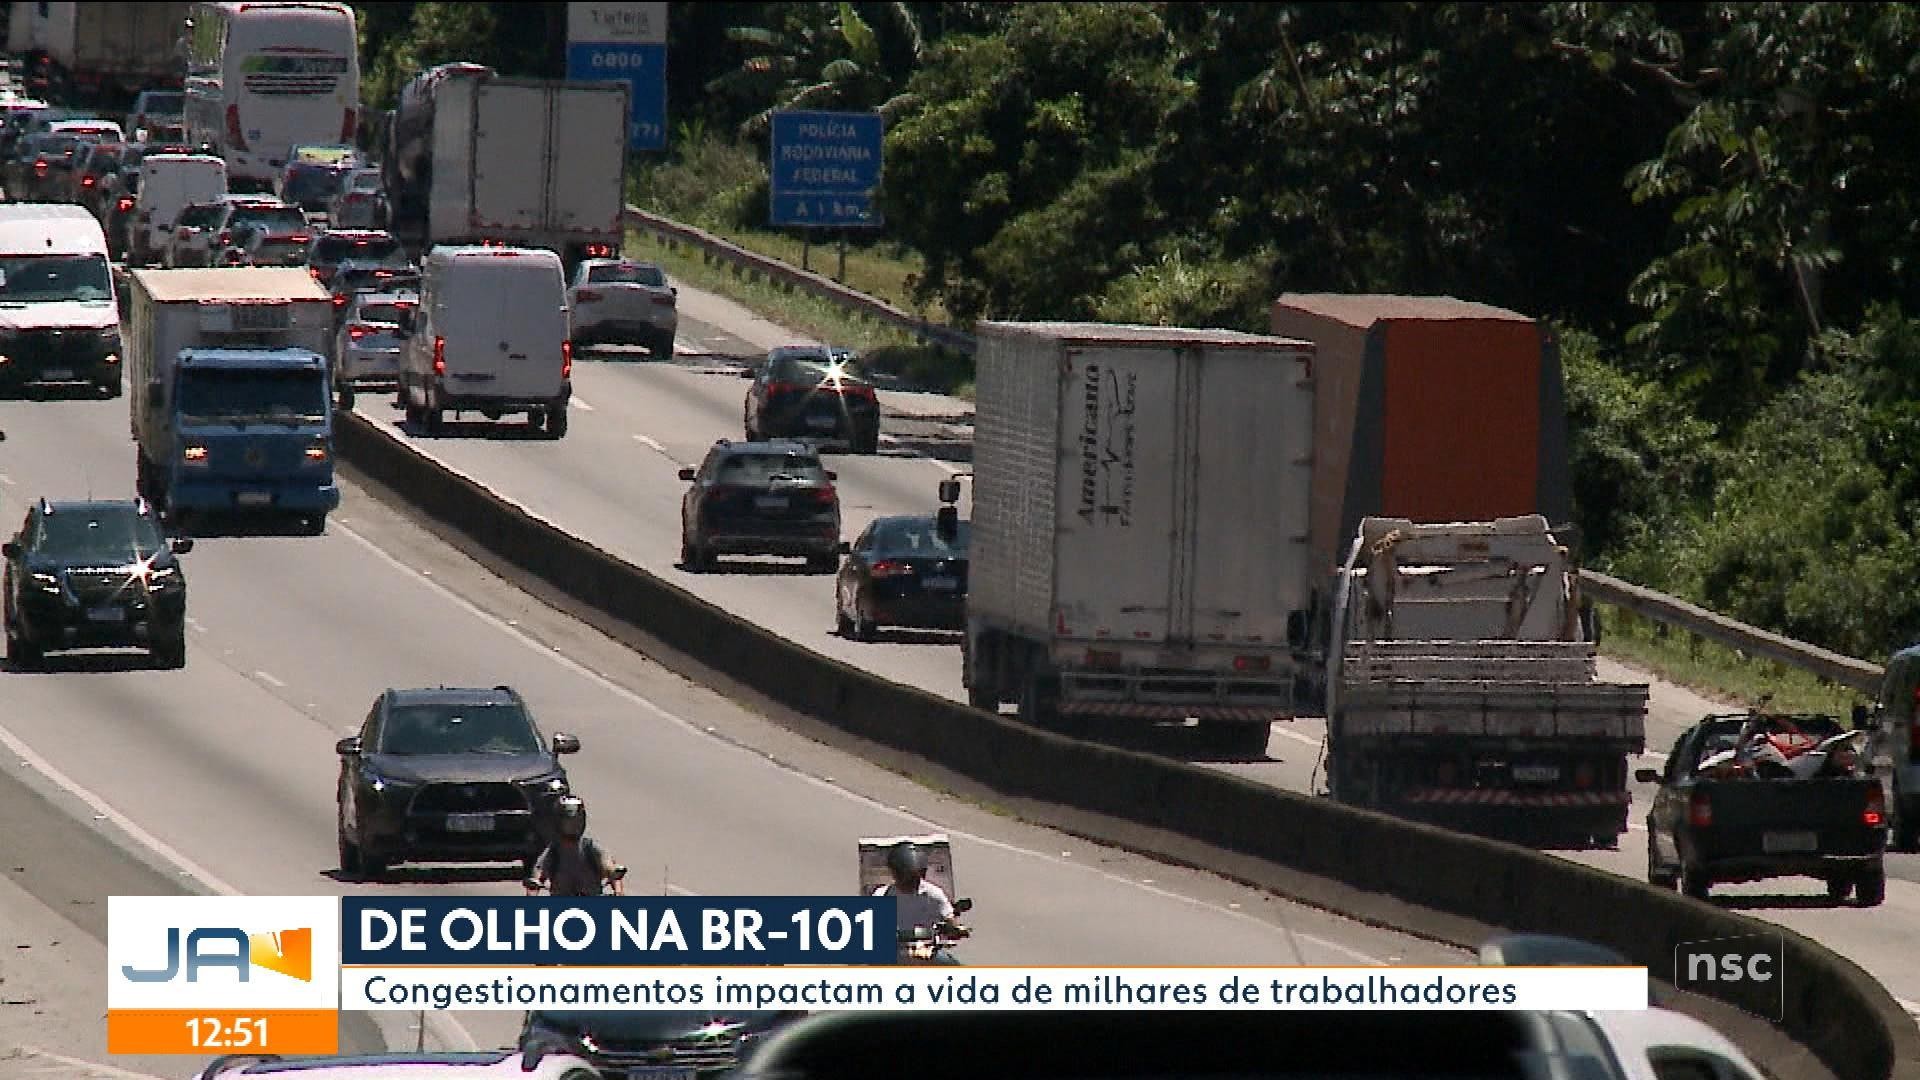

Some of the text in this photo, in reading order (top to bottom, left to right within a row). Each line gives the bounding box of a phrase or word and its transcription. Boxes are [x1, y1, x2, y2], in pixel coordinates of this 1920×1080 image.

[799, 121, 856, 138] POLÍCIA
[793, 168, 857, 182] FEDERAL
[796, 201, 808, 216] A
